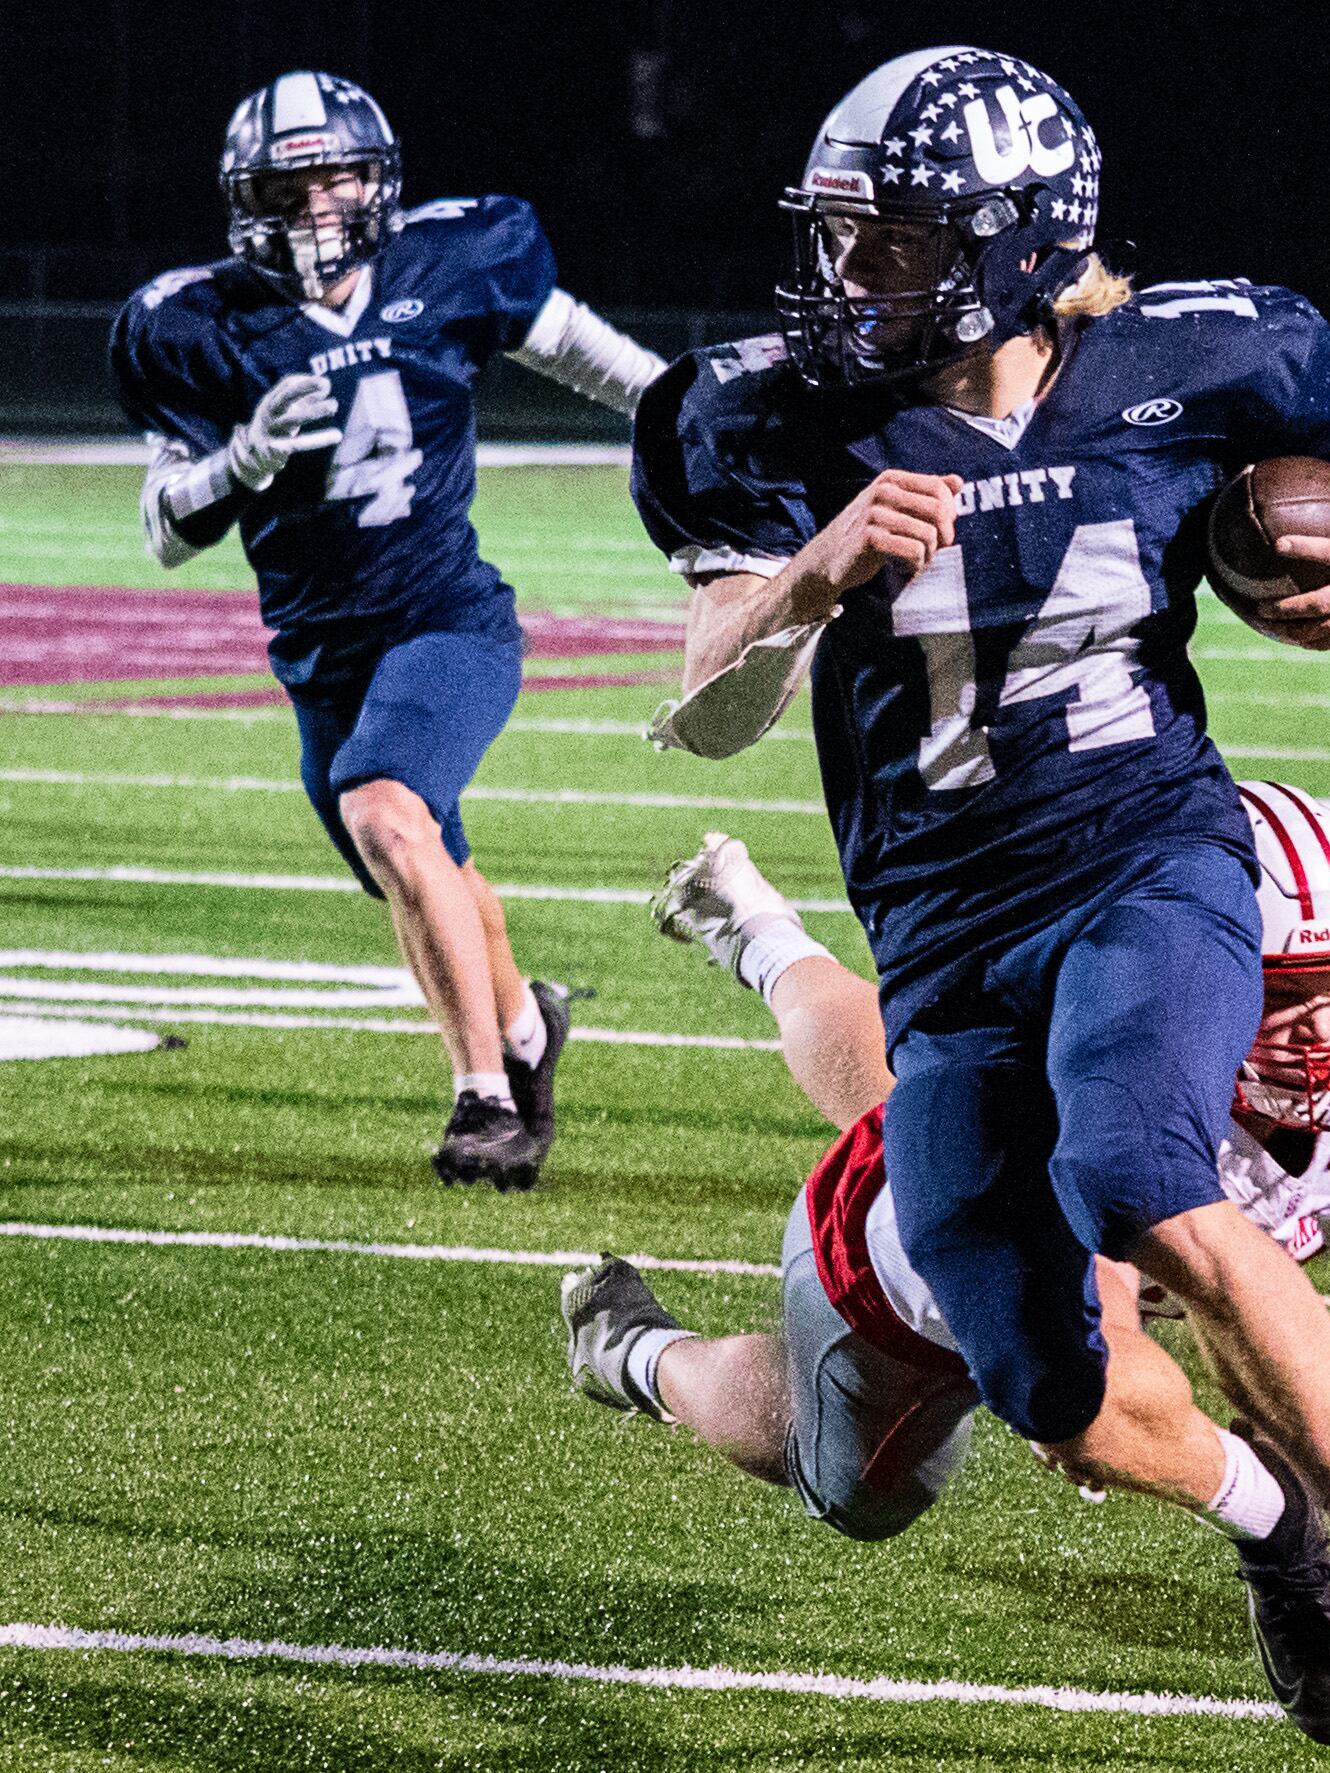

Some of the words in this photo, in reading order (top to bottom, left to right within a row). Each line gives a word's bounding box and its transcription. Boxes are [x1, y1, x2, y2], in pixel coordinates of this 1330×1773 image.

[963, 85, 1075, 185] UC
[310, 337, 391, 376] UNITY
[325, 371, 424, 528] 4
[955, 465, 1076, 516] UNITY
[891, 518, 1156, 791] 14
